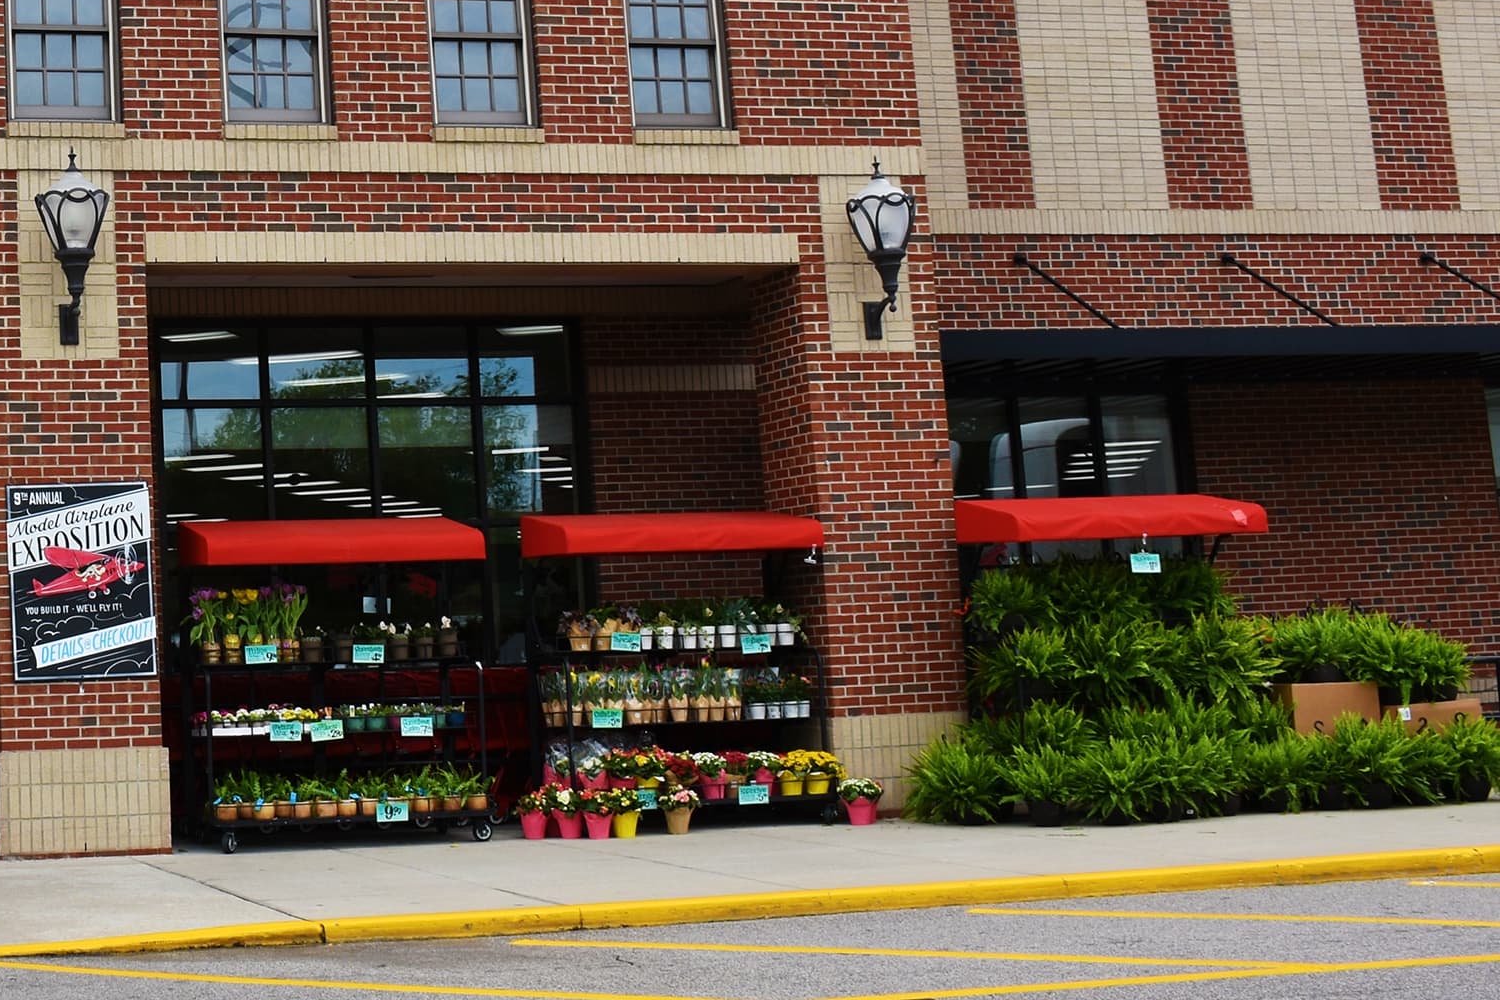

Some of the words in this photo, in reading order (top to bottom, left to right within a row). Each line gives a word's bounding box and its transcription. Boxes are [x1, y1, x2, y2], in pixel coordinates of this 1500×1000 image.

[29, 491, 66, 505] ANNUAL
[8, 513, 60, 538] Model
[65, 501, 136, 526] Airplane
[12, 513, 144, 567] EXPOSITION
[25, 606, 39, 615] YOU
[40, 605, 61, 614] BUILD
[62, 605, 69, 613] IT
[99, 603, 111, 612] FLY
[112, 602, 122, 611] IT!
[41, 637, 84, 665] DETAILS
[92, 620, 154, 650] CHECKOUT!
